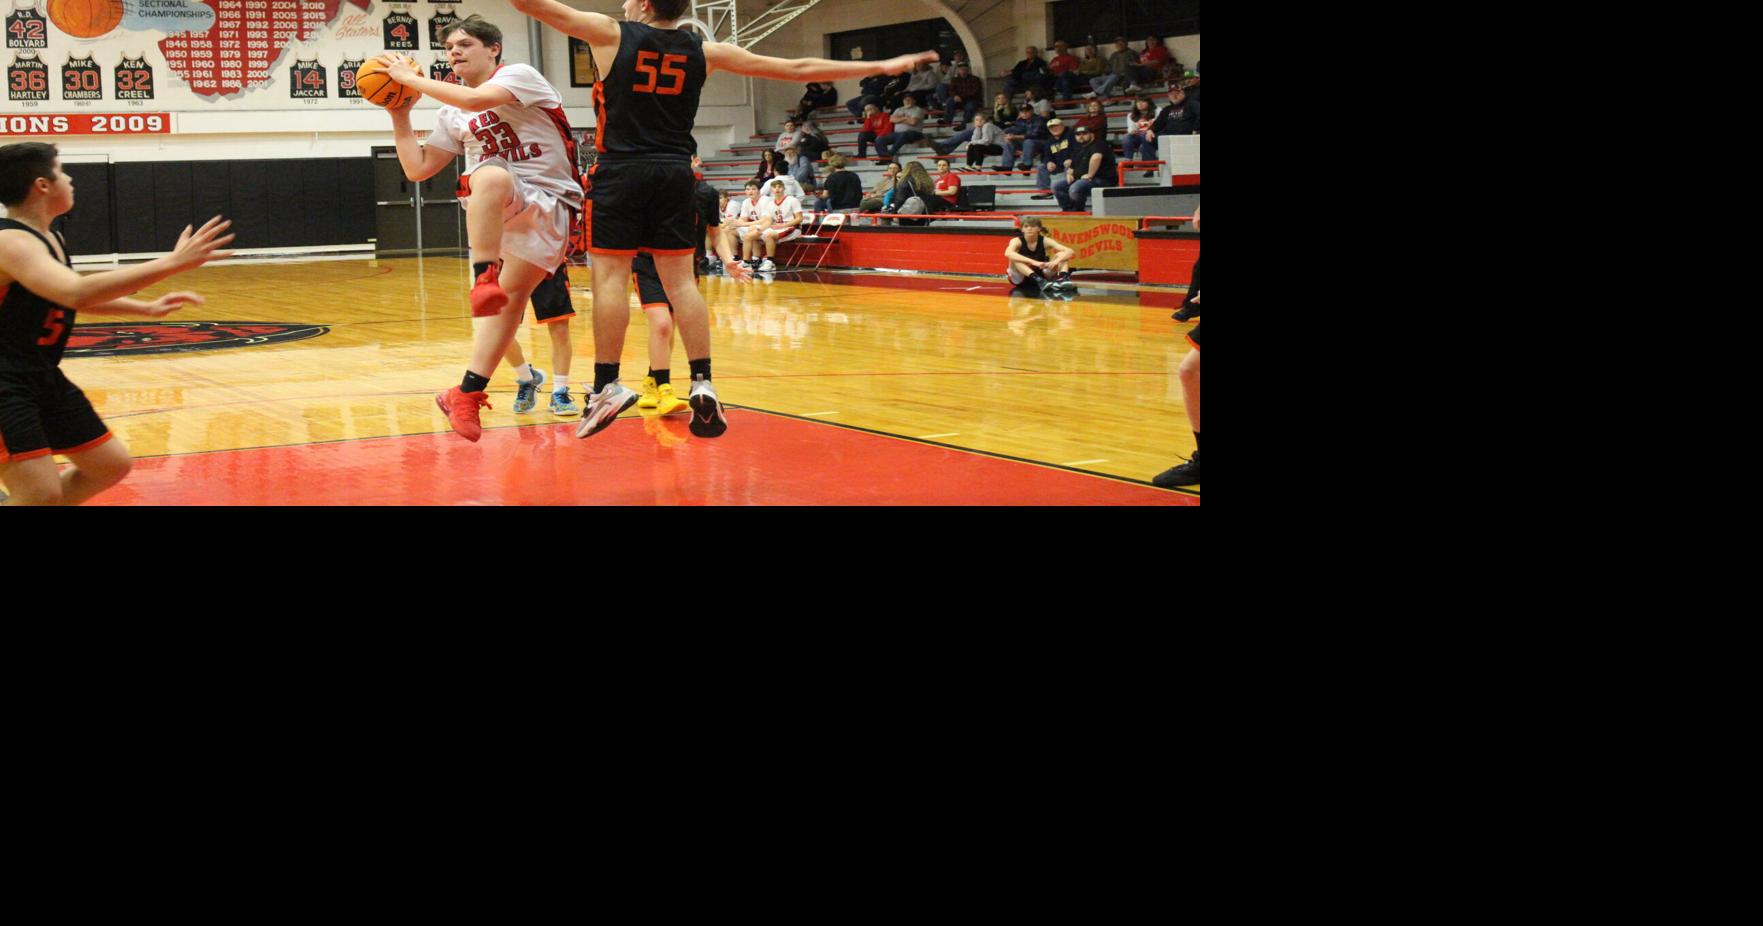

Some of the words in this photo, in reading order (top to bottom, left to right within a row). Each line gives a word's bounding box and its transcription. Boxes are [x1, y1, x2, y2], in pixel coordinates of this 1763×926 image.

[138, 0, 188, 8] SECTIONAL
[219, 1, 242, 9] 1964
[246, 1, 267, 9] 1990
[272, 1, 297, 9] 2004
[302, 2, 325, 10] 2010
[246, 11, 266, 19] 1991
[272, 11, 298, 19] 2005
[386, 16, 414, 25] BERNIE
[9, 19, 45, 39] 42
[219, 21, 241, 29] 1967
[247, 21, 269, 29] 1992
[219, 31, 239, 39] 1971
[390, 23, 410, 41] 4
[8, 40, 46, 48] BOLYARD
[165, 40, 188, 48] 1946
[166, 50, 188, 58] 1950
[220, 50, 241, 58] 1979
[15, 61, 43, 69] MARTIN
[69, 60, 94, 68] MIKE
[123, 61, 145, 69] KEN
[192, 60, 215, 68] 1960
[221, 60, 242, 68] 1980
[297, 62, 318, 70] MIKE
[192, 70, 213, 78] 1961
[632, 50, 688, 96] 55
[10, 70, 46, 91] 36
[64, 70, 99, 91] 30
[117, 69, 151, 90] 32
[294, 69, 324, 90] 14
[193, 80, 217, 88] 1962
[10, 91, 47, 99] HARTLEY
[64, 91, 101, 99] CHAMBERS
[118, 90, 151, 98] CREEL
[91, 116, 162, 132] 2009
[468, 110, 500, 135] RED
[474, 121, 521, 156] 33
[1079, 239, 1123, 259] DEVILS
[36, 309, 65, 346] 5
